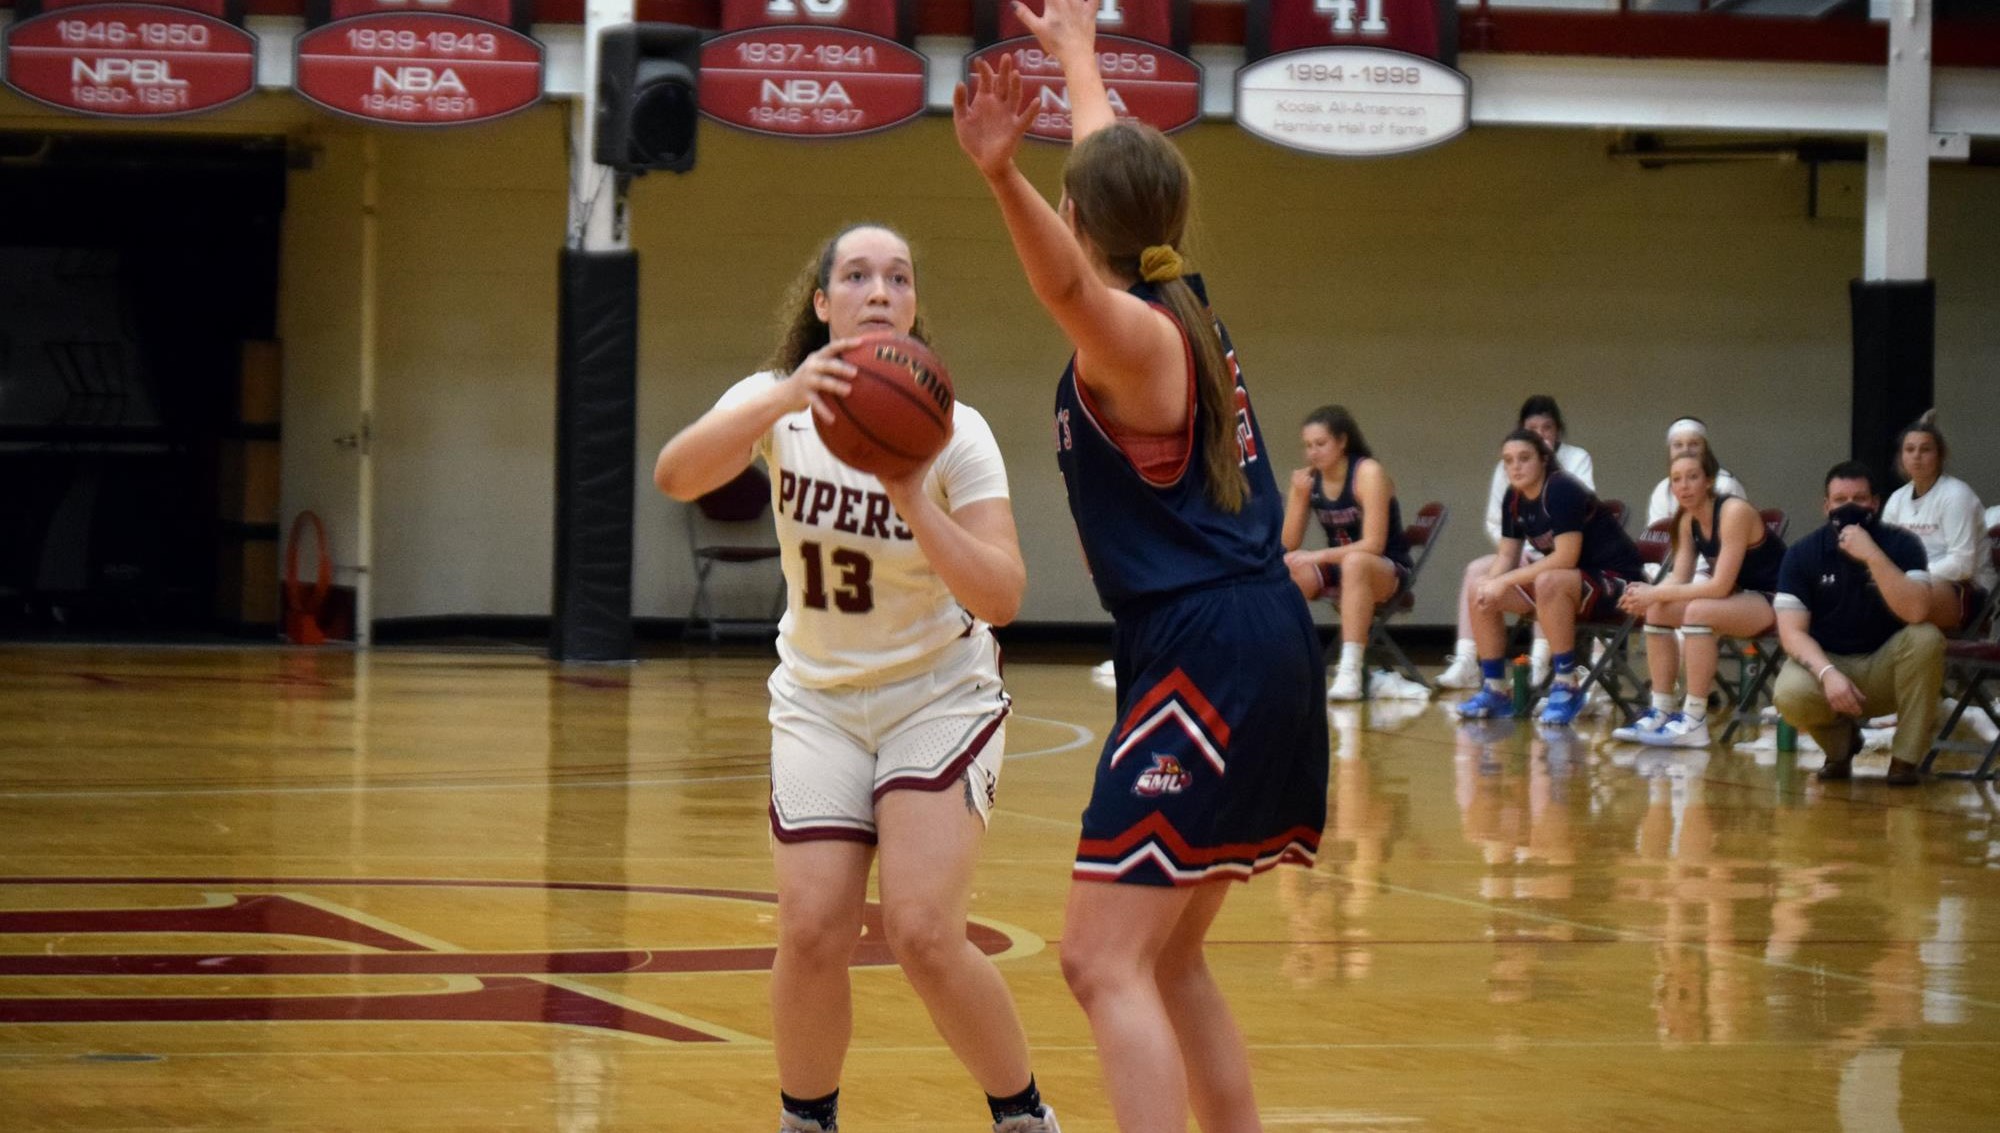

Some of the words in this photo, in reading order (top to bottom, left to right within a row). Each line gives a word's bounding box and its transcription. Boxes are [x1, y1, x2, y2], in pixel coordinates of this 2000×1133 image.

[57, 20, 208, 45] 1946-1950
[347, 29, 497, 53] 1939-1943
[737, 42, 876, 65] 1937-1941
[72, 57, 189, 86] NPBL
[373, 66, 466, 92] NBA
[762, 79, 852, 104] NBA
[1039, 85, 1128, 114] NA
[1276, 99, 1323, 113] Kodak
[1338, 121, 1366, 134] Hall
[1369, 121, 1385, 135] of
[800, 540, 874, 615] 13
